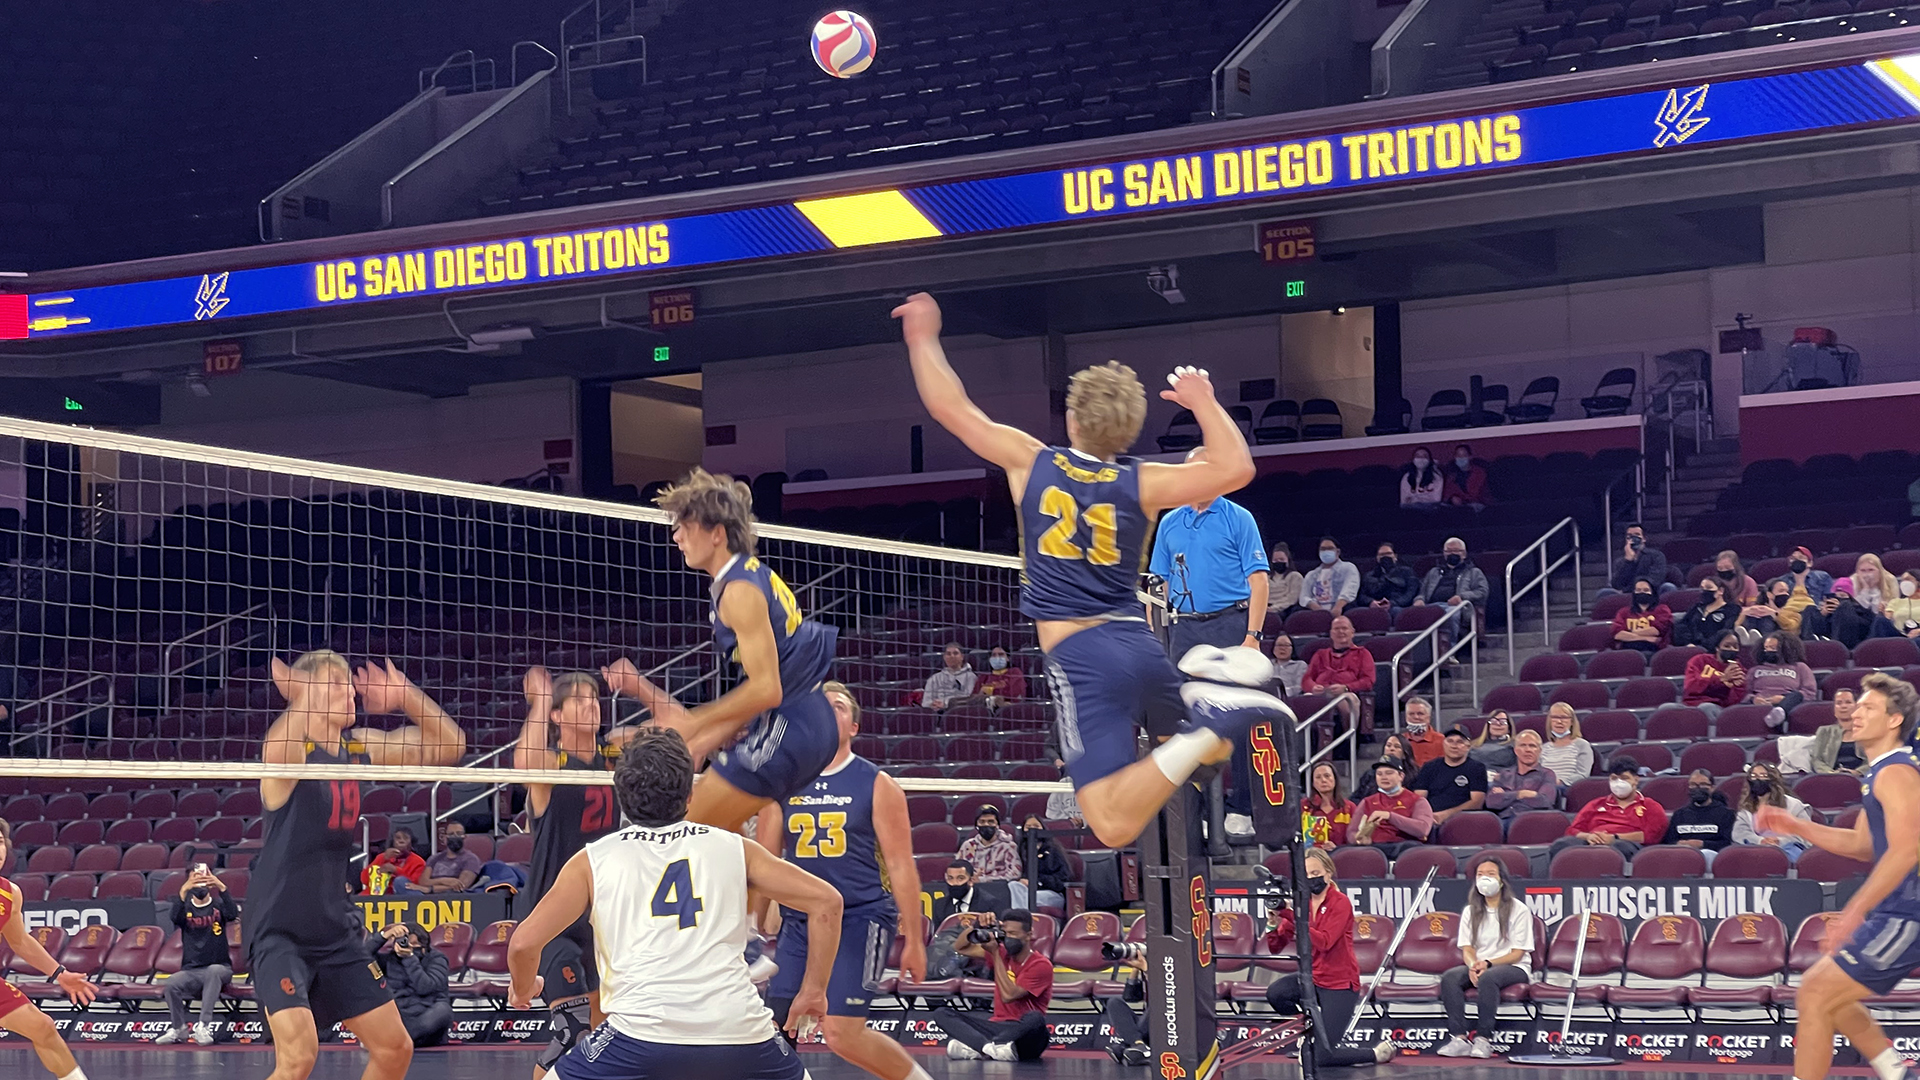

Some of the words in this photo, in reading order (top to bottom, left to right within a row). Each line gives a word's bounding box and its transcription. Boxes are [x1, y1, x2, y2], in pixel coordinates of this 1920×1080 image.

[1063, 168, 1115, 214] UC
[1124, 156, 1203, 207] SAN
[1214, 140, 1333, 197] DIEGO
[1342, 115, 1522, 181] TRITONS
[1266, 226, 1311, 238] SECTION
[1263, 238, 1315, 260] 105
[315, 261, 357, 302] UC
[364, 253, 427, 297] SAN
[434, 241, 527, 289] DIEGO
[533, 223, 670, 277] TRITONS
[1286, 281, 1305, 297] EXIT
[652, 305, 694, 325] 106
[206, 354, 242, 372] 107
[1038, 485, 1122, 566] 21
[328, 779, 361, 830] 19
[581, 785, 613, 833] 21
[620, 826, 710, 844] TRITONS
[788, 812, 847, 858] 23
[650, 857, 703, 931] 4
[1369, 887, 1437, 918] MILK
[1572, 886, 1691, 919] MUSCLE
[1699, 886, 1774, 918] MILK
[24, 908, 108, 936] EICO
[355, 901, 409, 933] HT
[417, 900, 472, 933] ON!
[1163, 956, 1177, 996] sports
[75, 1021, 122, 1033] ROCKET
[125, 1021, 172, 1032] ROCKET
[226, 1021, 263, 1032] ROCK
[451, 1020, 490, 1031] OCKET
[494, 1020, 545, 1031] ROCKET
[865, 1020, 899, 1031] CKET
[1046, 1023, 1094, 1035] OCKET
[1164, 997, 1179, 1046] imports
[501, 1031, 531, 1040] Mortgage
[914, 1032, 948, 1041] Mortgage
[1049, 1036, 1079, 1044] ortgage
[1381, 1028, 1449, 1041] ROCKET
[1537, 1031, 1608, 1046] ROCKET
[1615, 1034, 1688, 1048] ROCKET
[1696, 1034, 1771, 1049] ROCKET
[1628, 1047, 1672, 1057] Mortgage
[1708, 1047, 1754, 1058] Mortgage
